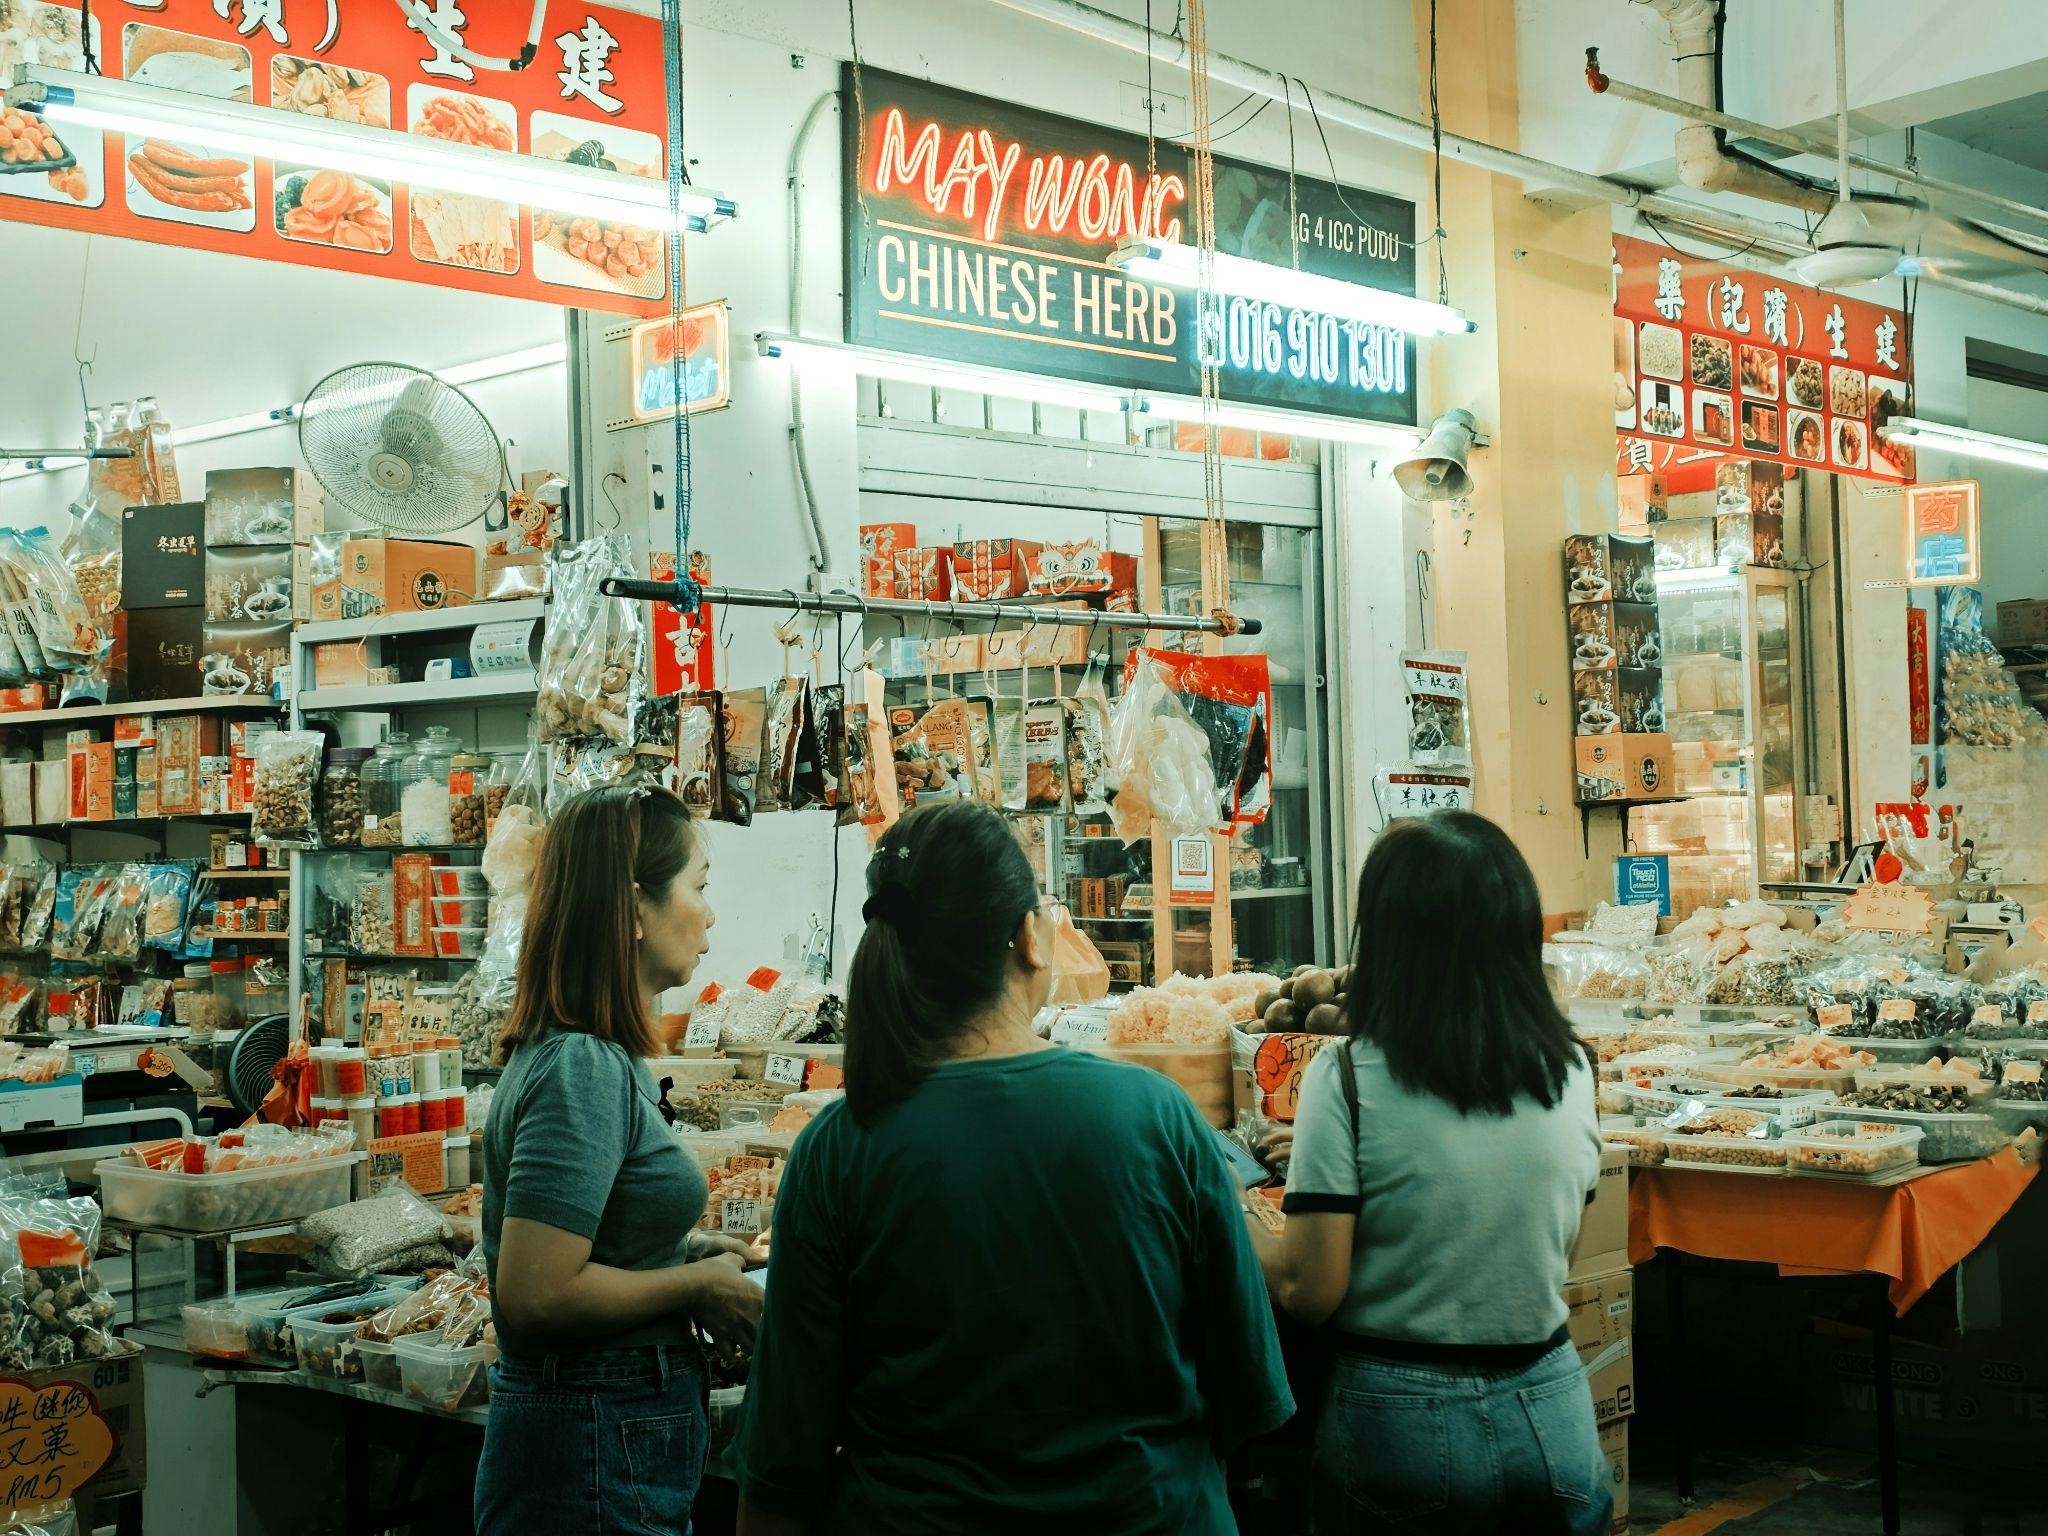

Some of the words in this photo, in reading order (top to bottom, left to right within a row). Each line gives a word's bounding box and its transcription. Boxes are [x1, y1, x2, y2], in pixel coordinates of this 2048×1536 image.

[874, 108, 1021, 243] MAY
[1025, 153, 1186, 244] WONG
[1314, 215, 1325, 246] 4
[1327, 219, 1354, 253] ICC
[1359, 225, 1400, 263] PUDU
[878, 234, 1059, 330] CHINESE
[1074, 270, 1178, 347] HERB
[1230, 296, 1281, 374] 016
[1287, 306, 1338, 387] 910
[1340, 316, 1407, 396] 1301
[1919, 491, 1966, 577] 药店
